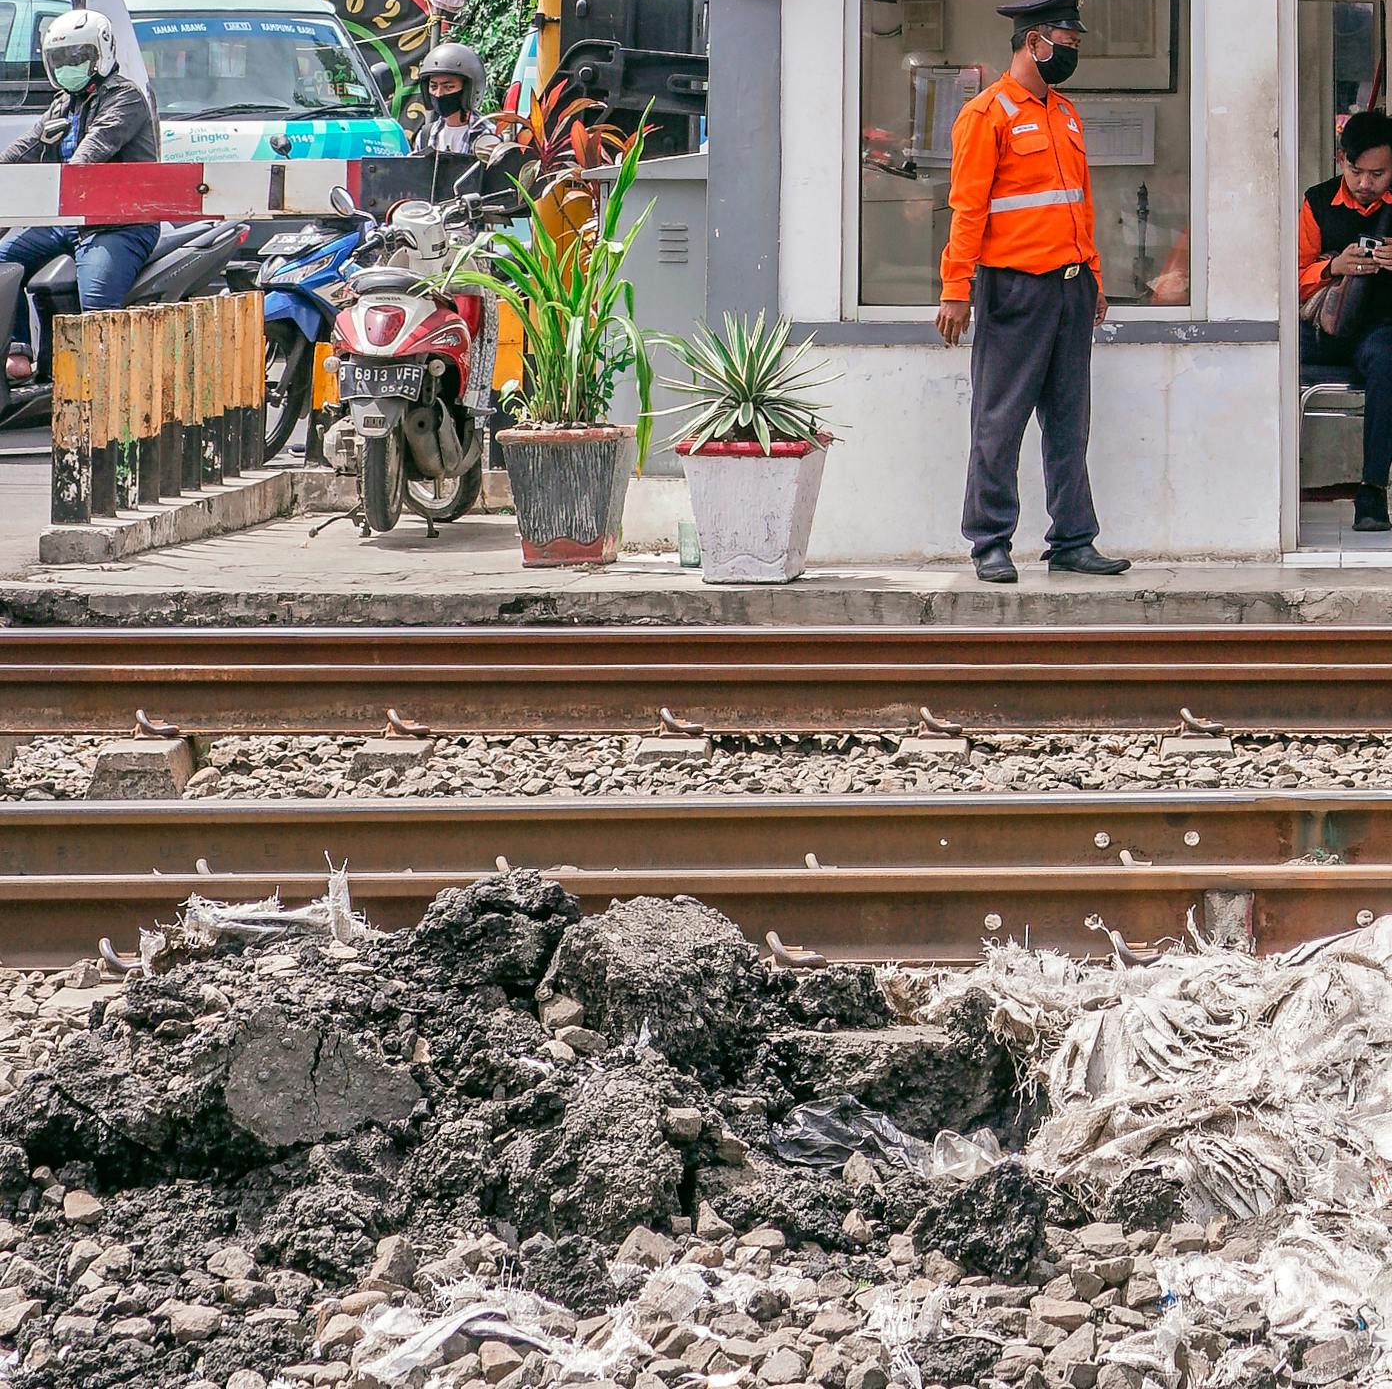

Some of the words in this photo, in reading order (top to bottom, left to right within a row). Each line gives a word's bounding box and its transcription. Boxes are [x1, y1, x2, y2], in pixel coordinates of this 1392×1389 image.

[151, 24, 178, 35] TANAH
[180, 22, 207, 33] ABANG
[190, 132, 230, 144] Lingko
[355, 366, 388, 382] 6813
[396, 366, 420, 382] VFF
